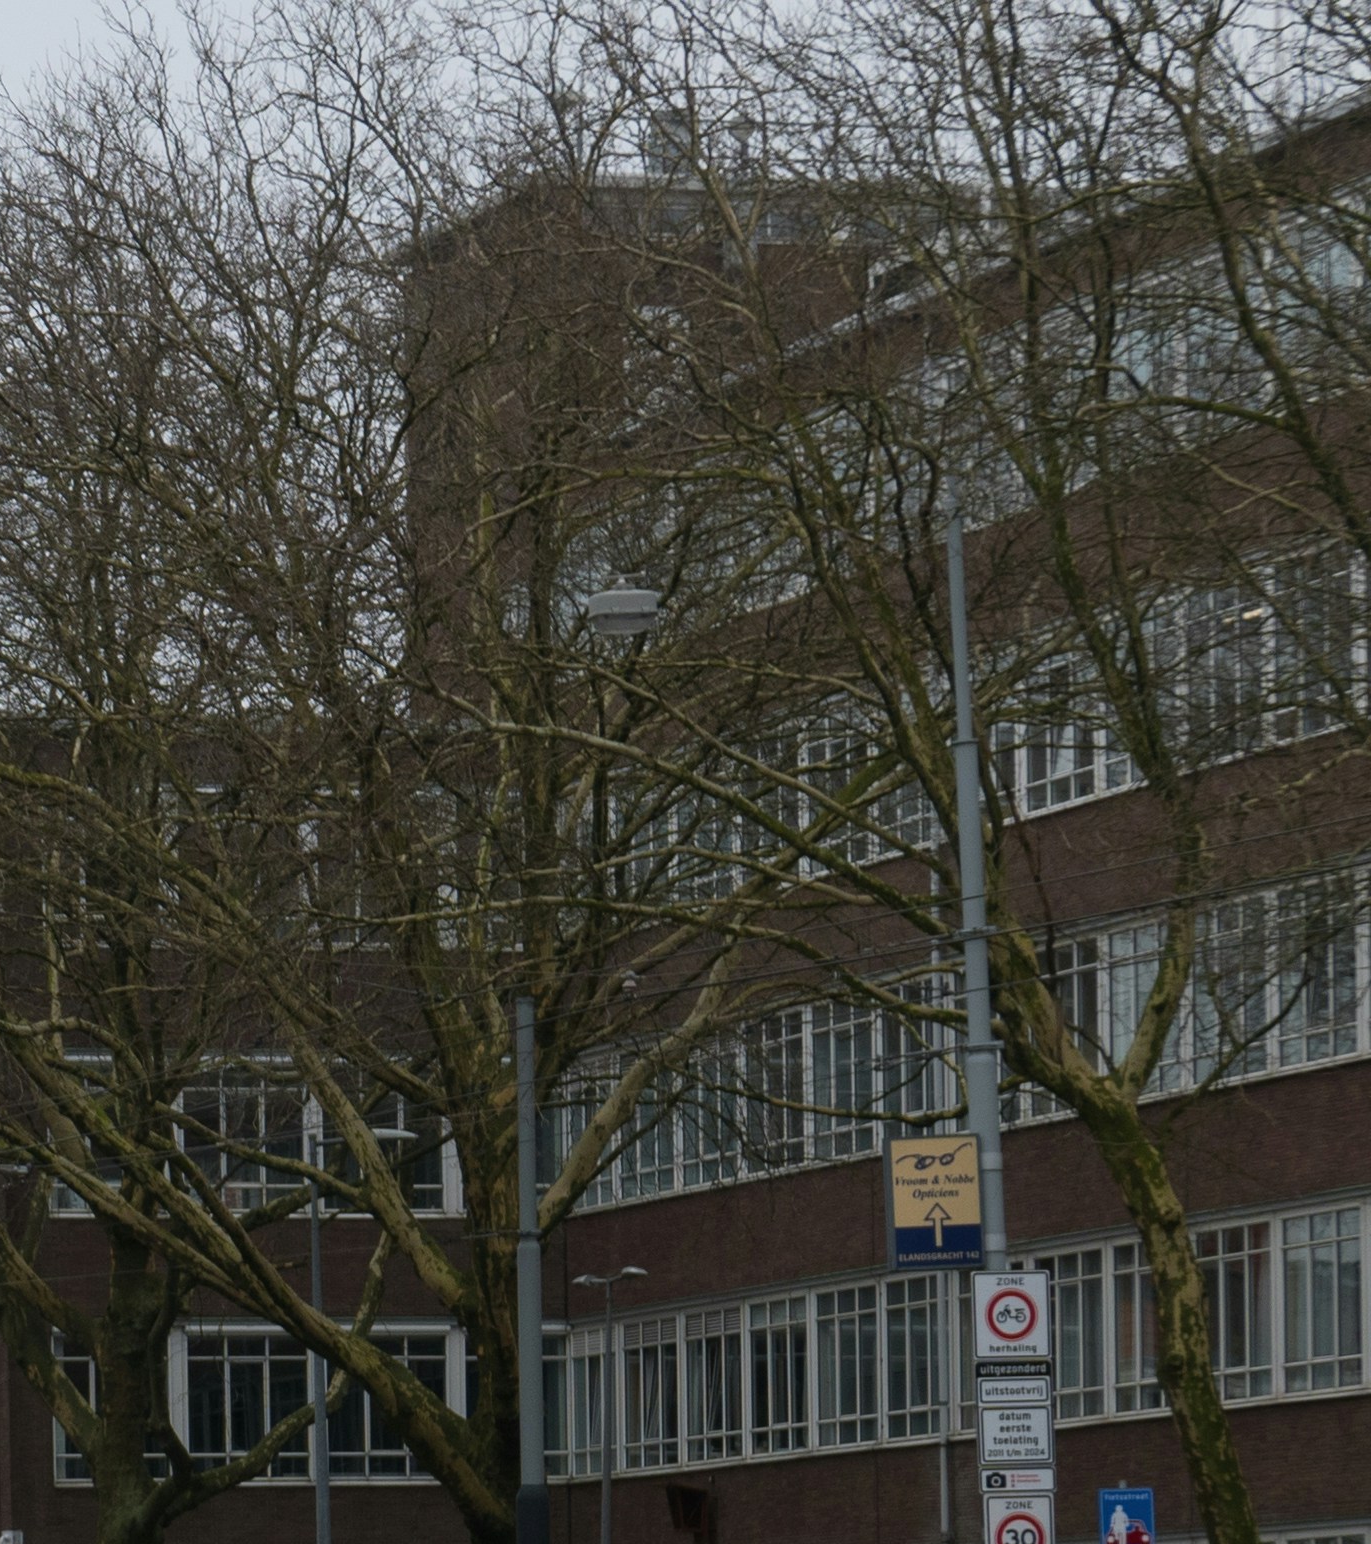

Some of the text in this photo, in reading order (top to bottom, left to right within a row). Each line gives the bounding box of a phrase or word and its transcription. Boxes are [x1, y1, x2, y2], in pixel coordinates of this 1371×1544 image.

[894, 1173, 976, 1186] Vroom & Nobbe
[911, 1187, 960, 1201] Opticiens
[898, 1251, 964, 1262] ELANDSGRACHT
[995, 1276, 1025, 1287] ZONE
[988, 1344, 1038, 1354] herhaling
[979, 1363, 1047, 1377] uitgezonderd
[984, 1385, 1044, 1398] uitstootvrij
[998, 1411, 1032, 1421] datum
[999, 1423, 1032, 1433] eerste
[993, 1435, 1039, 1446] toelating
[1006, 1448, 1022, 1457] t/m
[1024, 1447, 1046, 1456] 2024
[1005, 1500, 1034, 1510] ZONE
